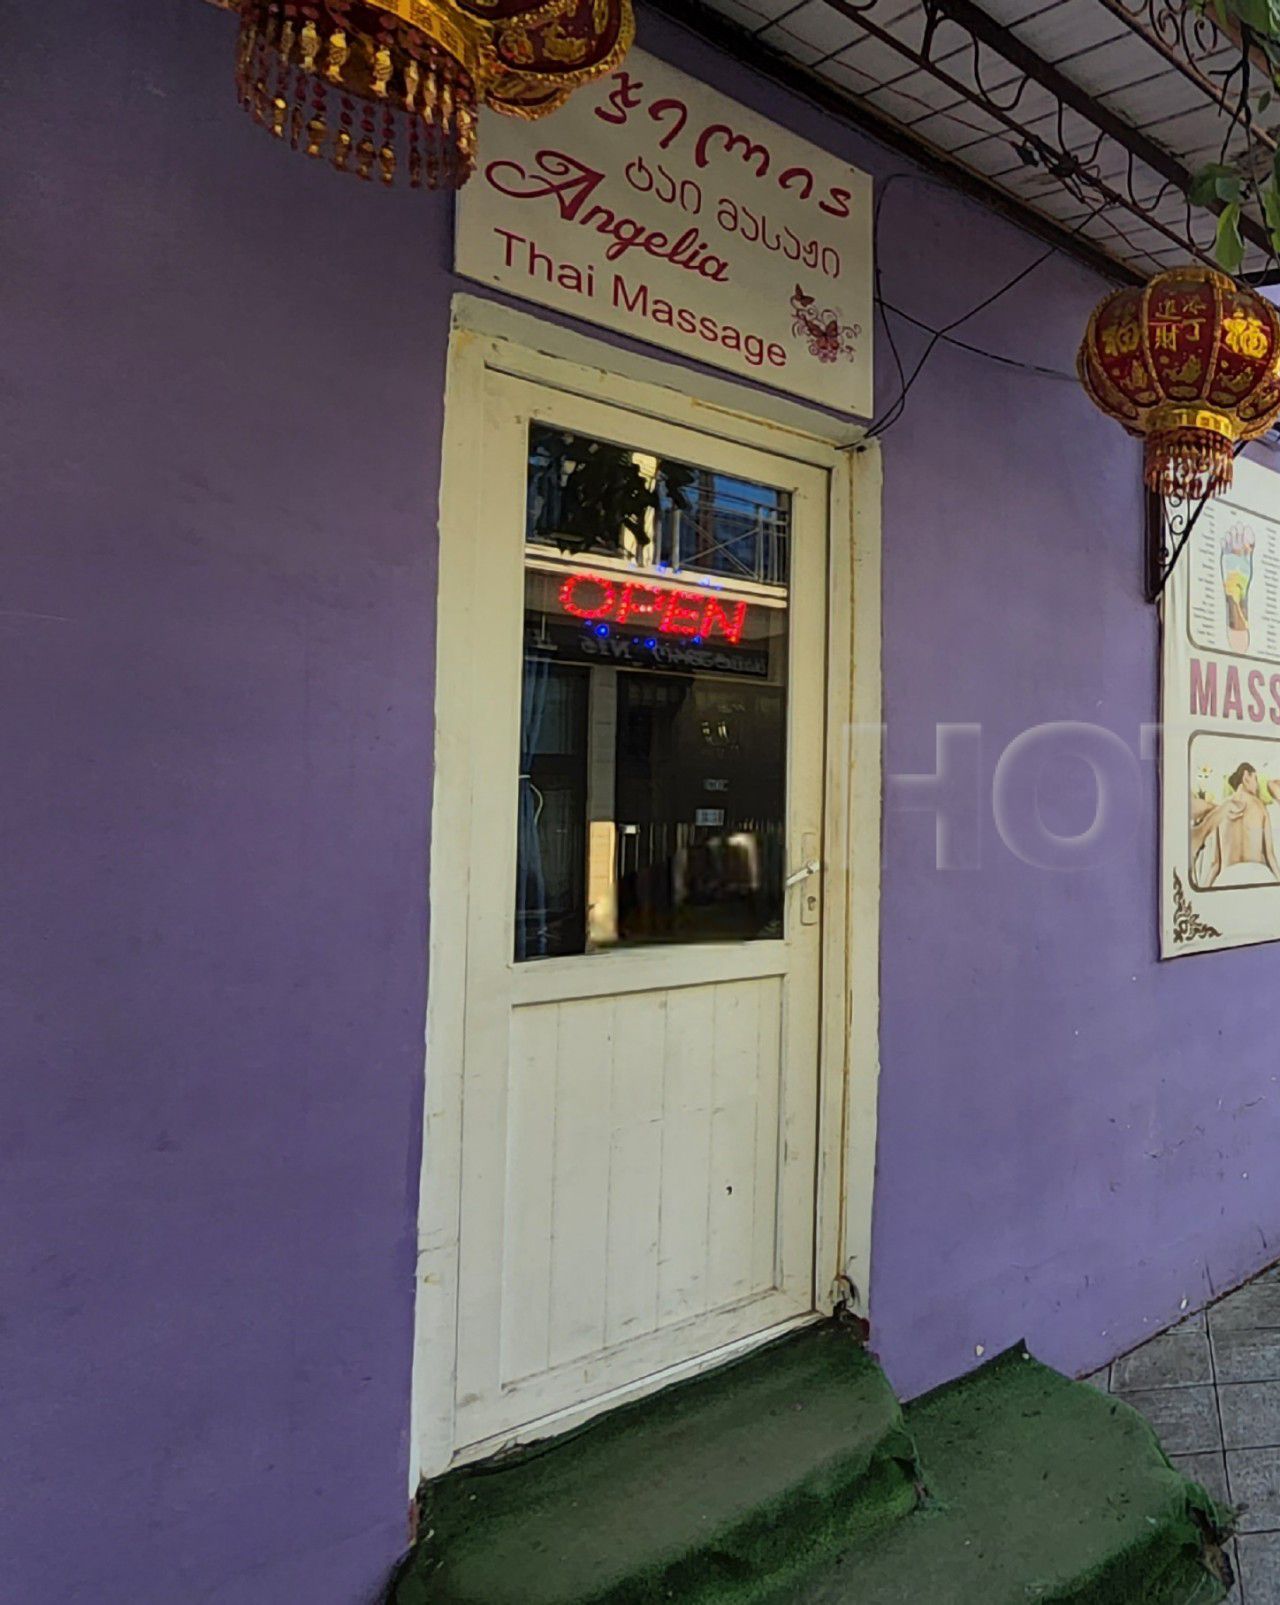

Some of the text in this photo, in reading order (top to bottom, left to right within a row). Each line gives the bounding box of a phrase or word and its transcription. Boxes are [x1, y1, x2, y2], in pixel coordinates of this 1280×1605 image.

[485, 150, 730, 282] Angelia
[625, 156, 841, 278] ტაი მასაჟი
[494, 228, 788, 367] Thai Massage
[559, 572, 748, 645] OPEN
